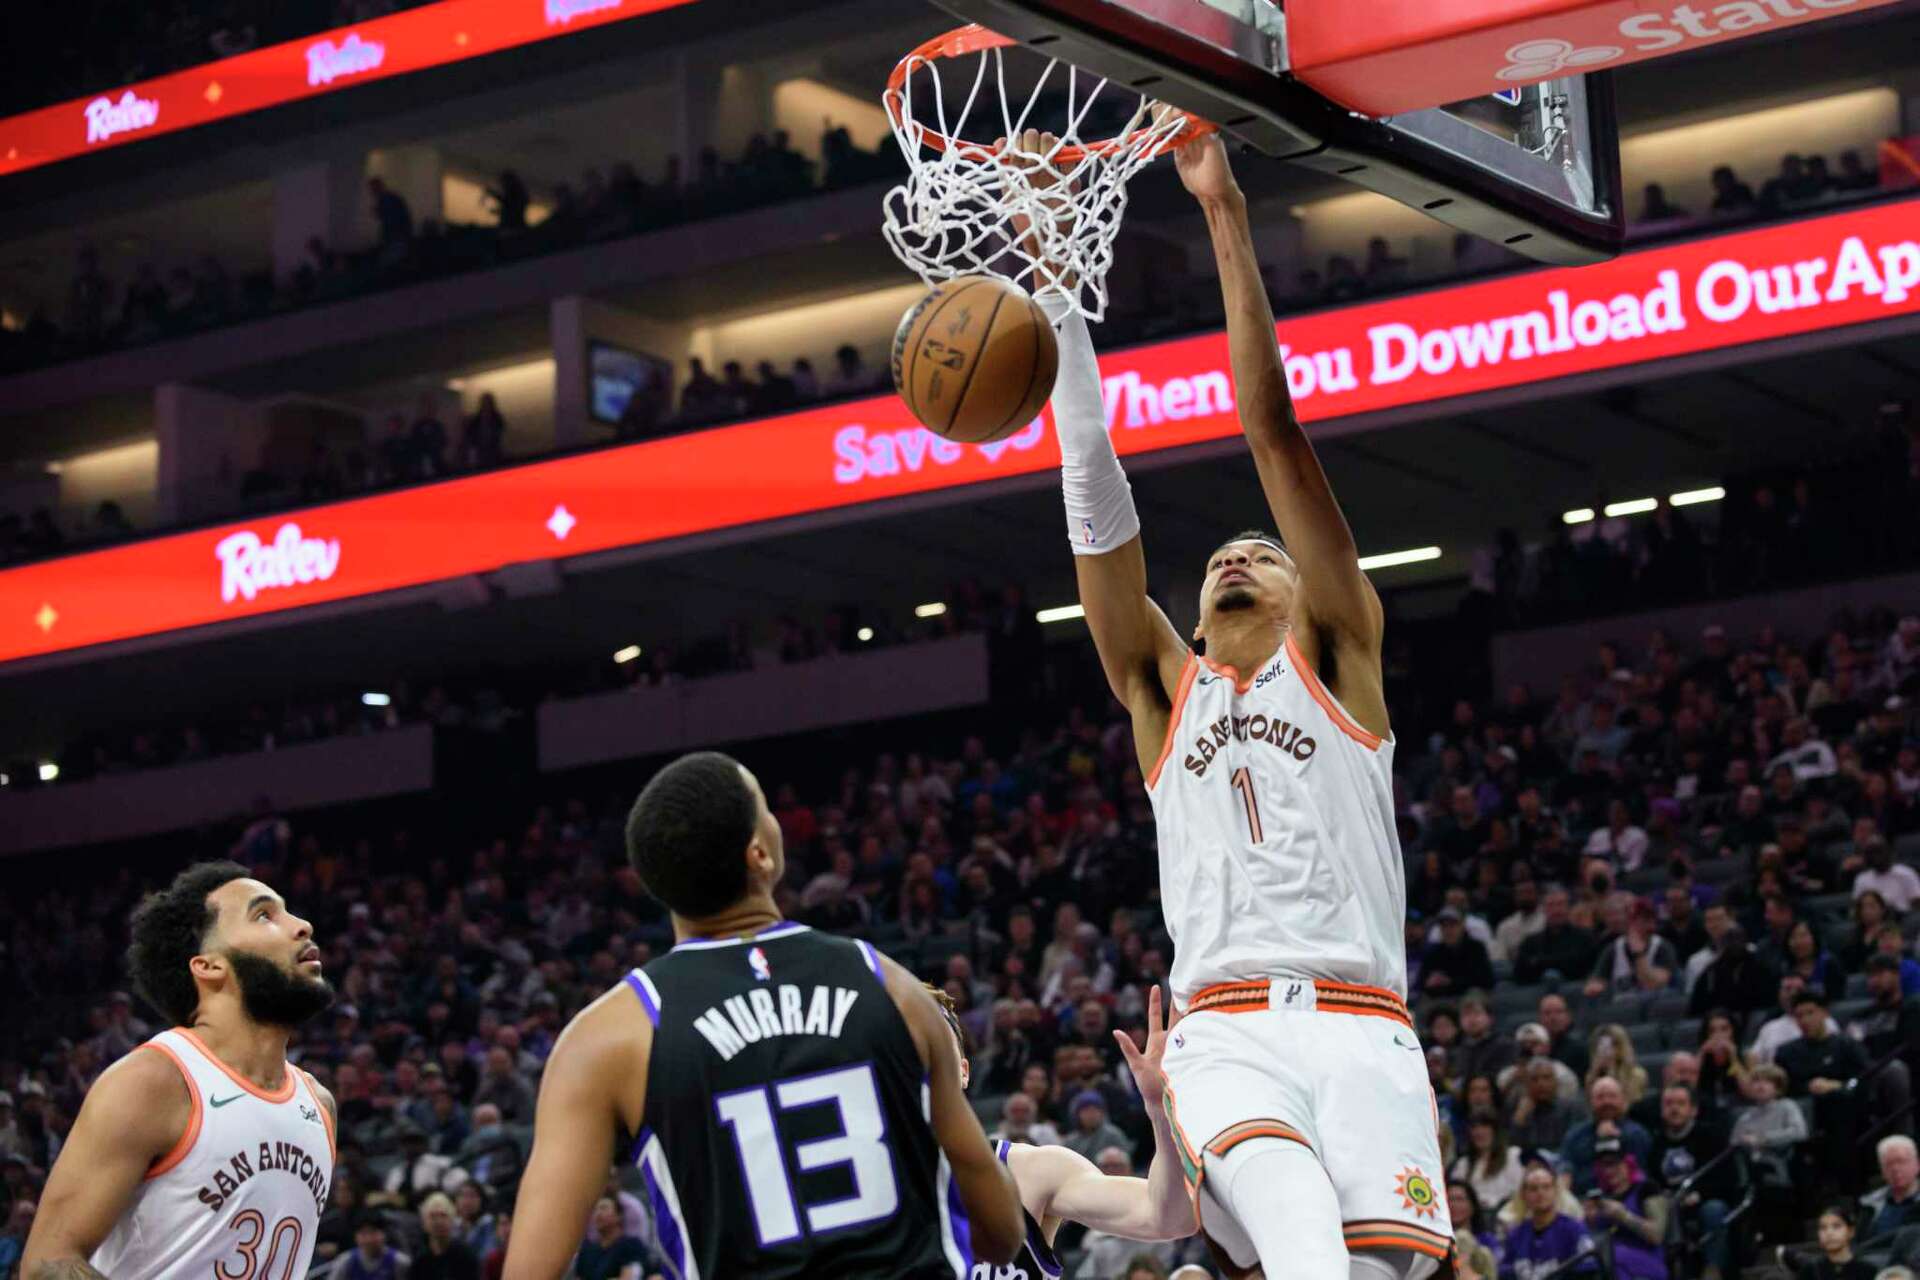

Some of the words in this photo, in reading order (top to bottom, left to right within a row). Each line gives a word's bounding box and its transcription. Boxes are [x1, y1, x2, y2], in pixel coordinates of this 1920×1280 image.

[1279, 344, 1358, 400] ou
[1368, 269, 1686, 385] Download
[1231, 766, 1264, 845] 1
[693, 983, 859, 1062] MURRAY
[198, 1151, 254, 1213] SAN
[713, 1060, 899, 1249] 13
[214, 1208, 303, 1280] 30
